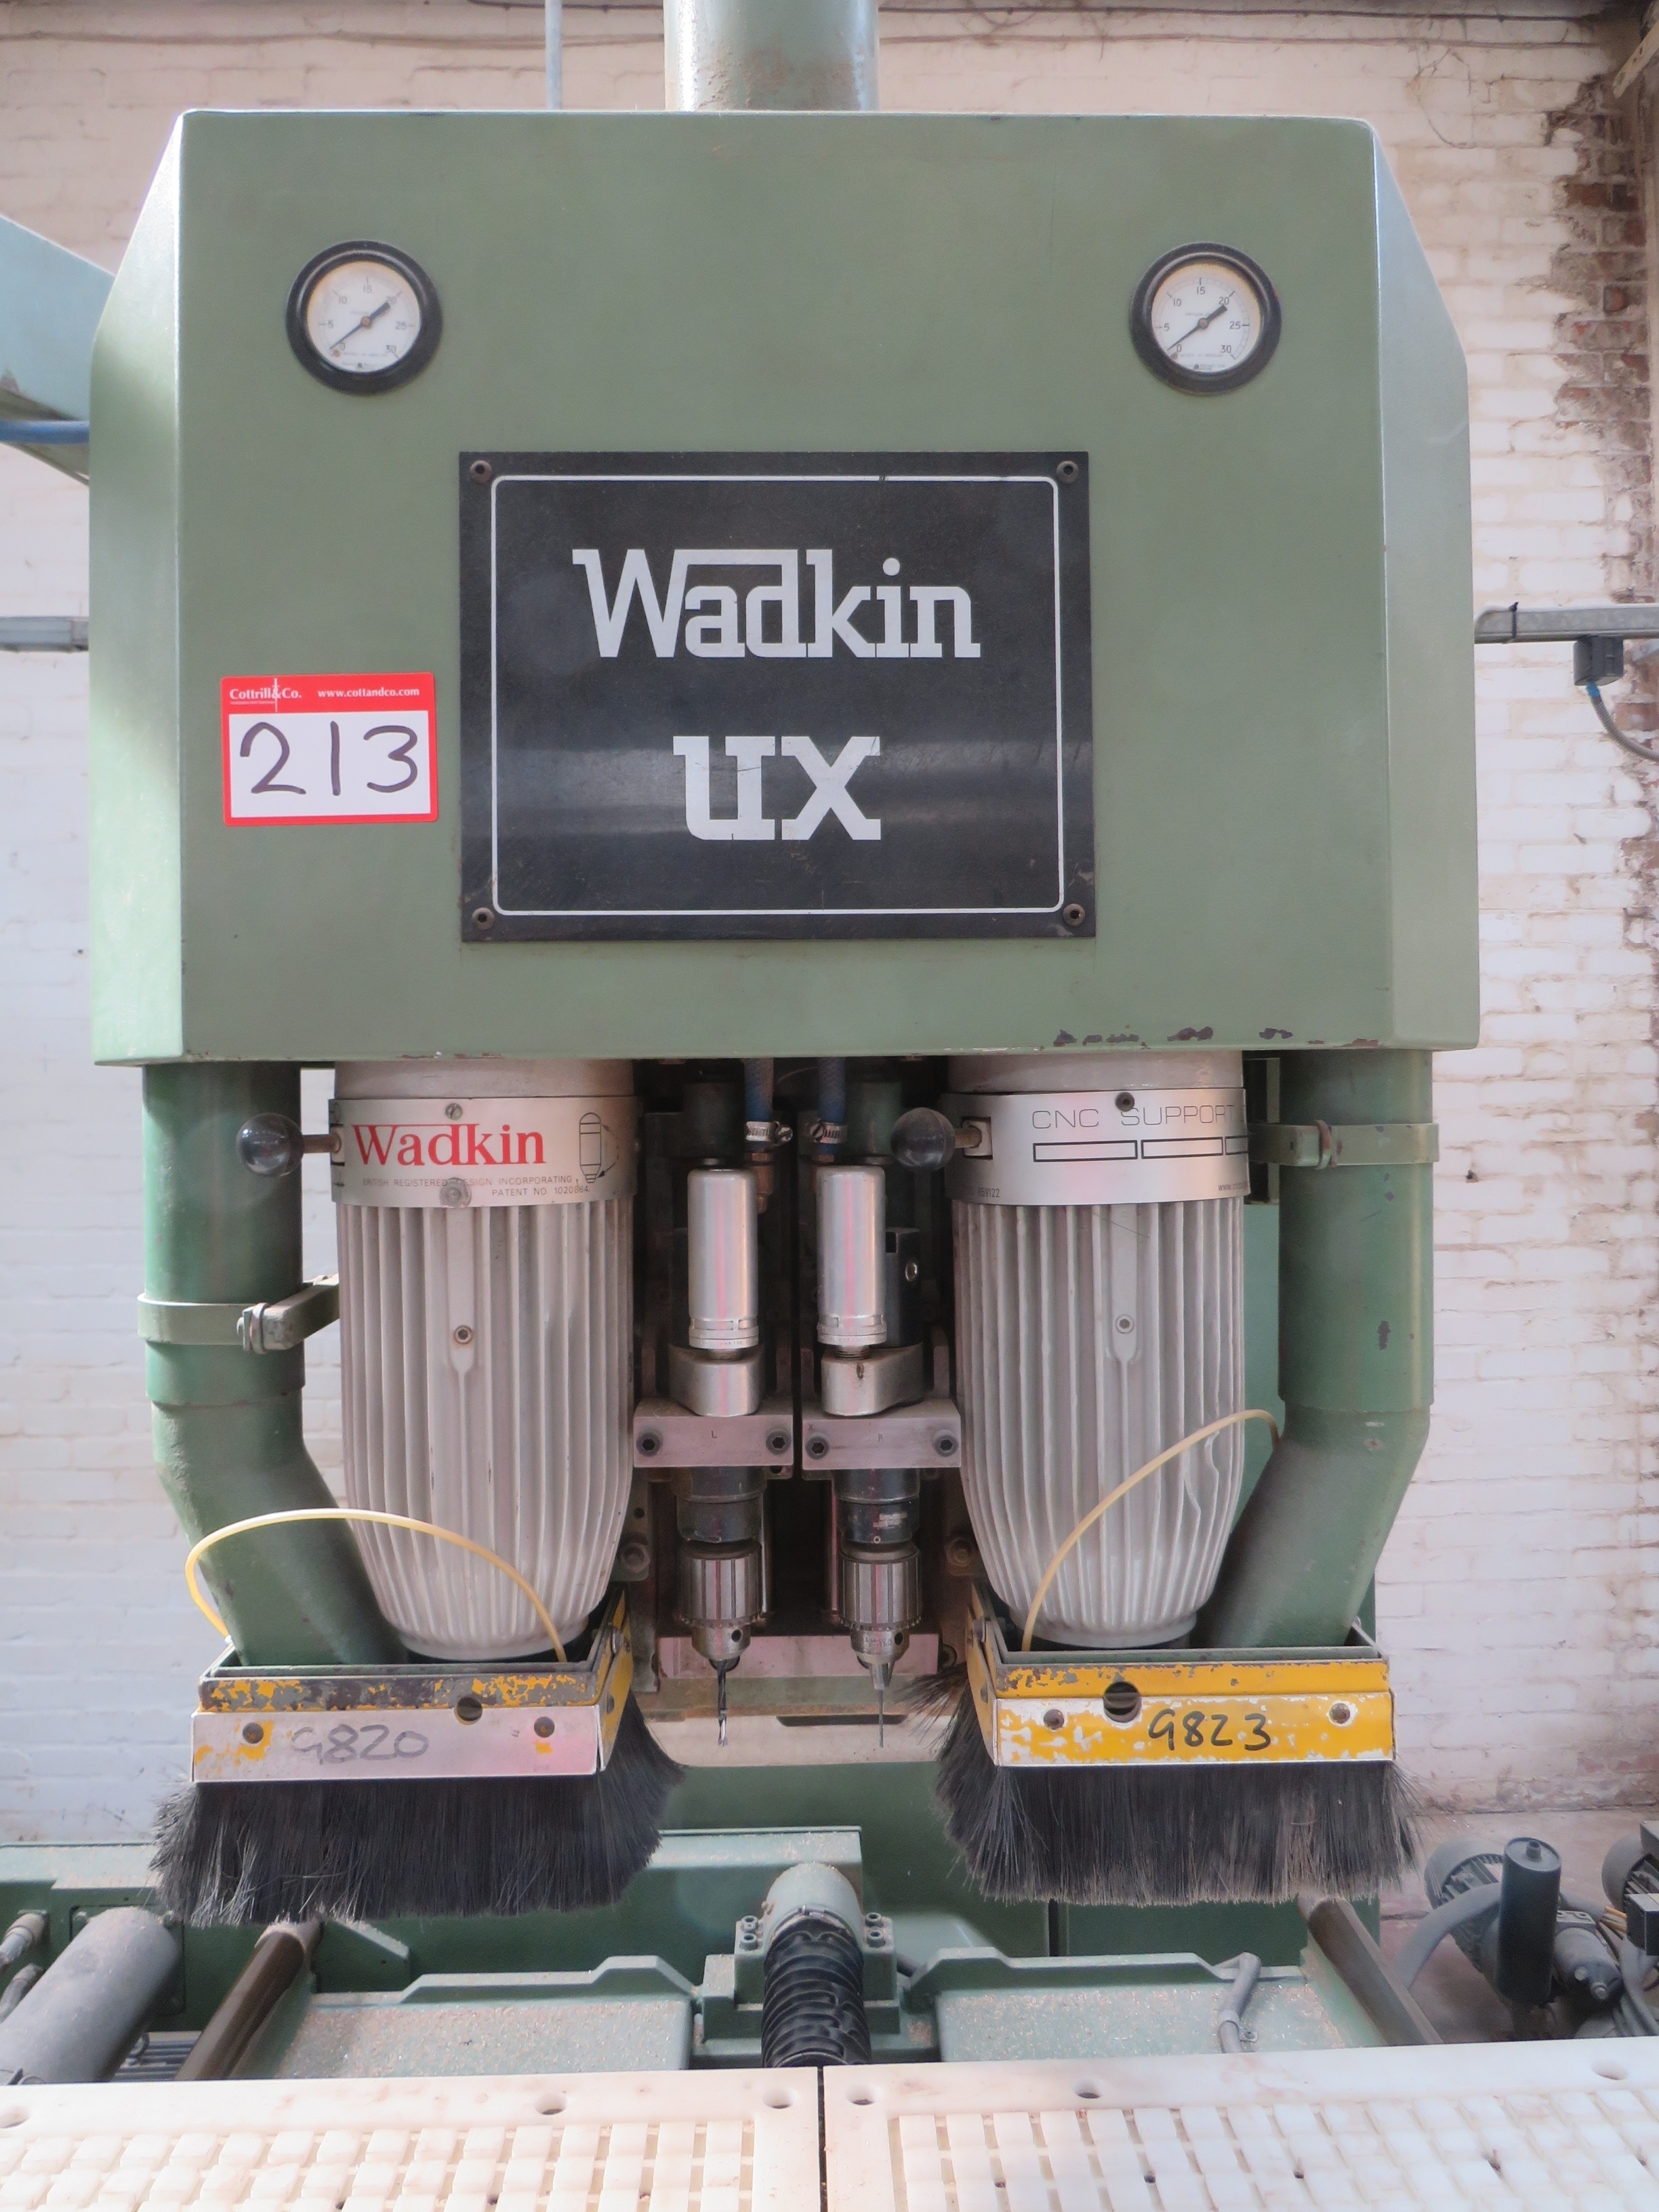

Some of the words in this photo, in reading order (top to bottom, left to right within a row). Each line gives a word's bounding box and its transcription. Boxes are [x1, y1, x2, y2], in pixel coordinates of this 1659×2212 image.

[1196, 287, 1206, 295] 15
[1172, 299, 1182, 307] 10
[1218, 297, 1229, 306] 20
[1164, 323, 1170, 331] 5
[1229, 321, 1241, 330] 25
[1176, 344, 1182, 352] 0
[1221, 345, 1231, 354] 30
[572, 549, 981, 658] Wadkin
[318, 687, 420, 698] www.cottandco.com
[240, 721, 418, 796] 213
[673, 736, 881, 841] UX
[1032, 1108, 1099, 1129] CNC
[1121, 1103, 1234, 1126] SUPPORT
[352, 1122, 547, 1166] Wadkin
[393, 1179, 447, 1187] REGISTERED
[457, 1178, 493, 1187] ESIGN
[499, 1174, 572, 1185] INCORPORATING
[491, 1188, 527, 1196] PATENT
[711, 1430, 718, 1439] L
[877, 1433, 884, 1442] R
[1147, 1708, 1272, 1751] 9823
